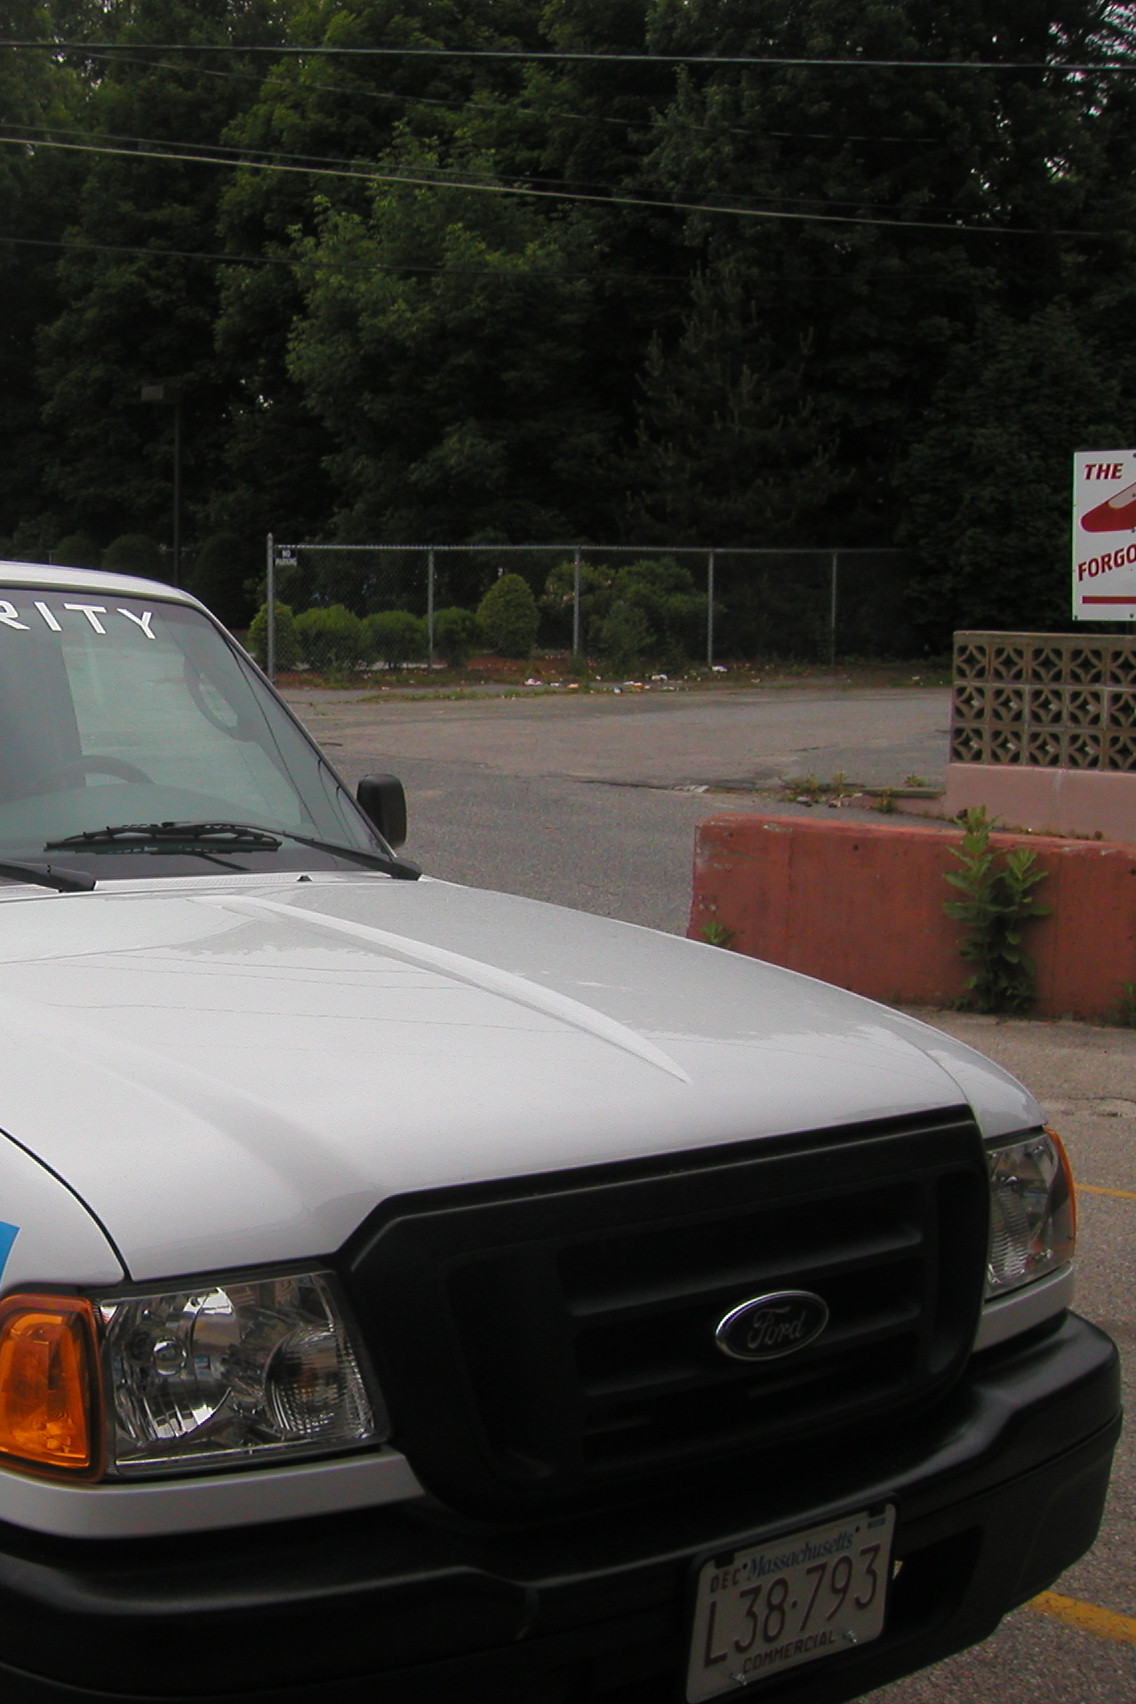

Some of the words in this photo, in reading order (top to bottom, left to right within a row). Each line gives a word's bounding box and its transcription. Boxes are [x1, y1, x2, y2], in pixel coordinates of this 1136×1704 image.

[1084, 462, 1124, 481] THE
[747, 1305, 807, 1349] Ford
[709, 1567, 742, 1594] DEC
[747, 1530, 855, 1580] Massachusetts
[742, 1629, 837, 1674] COMMERCIAL
